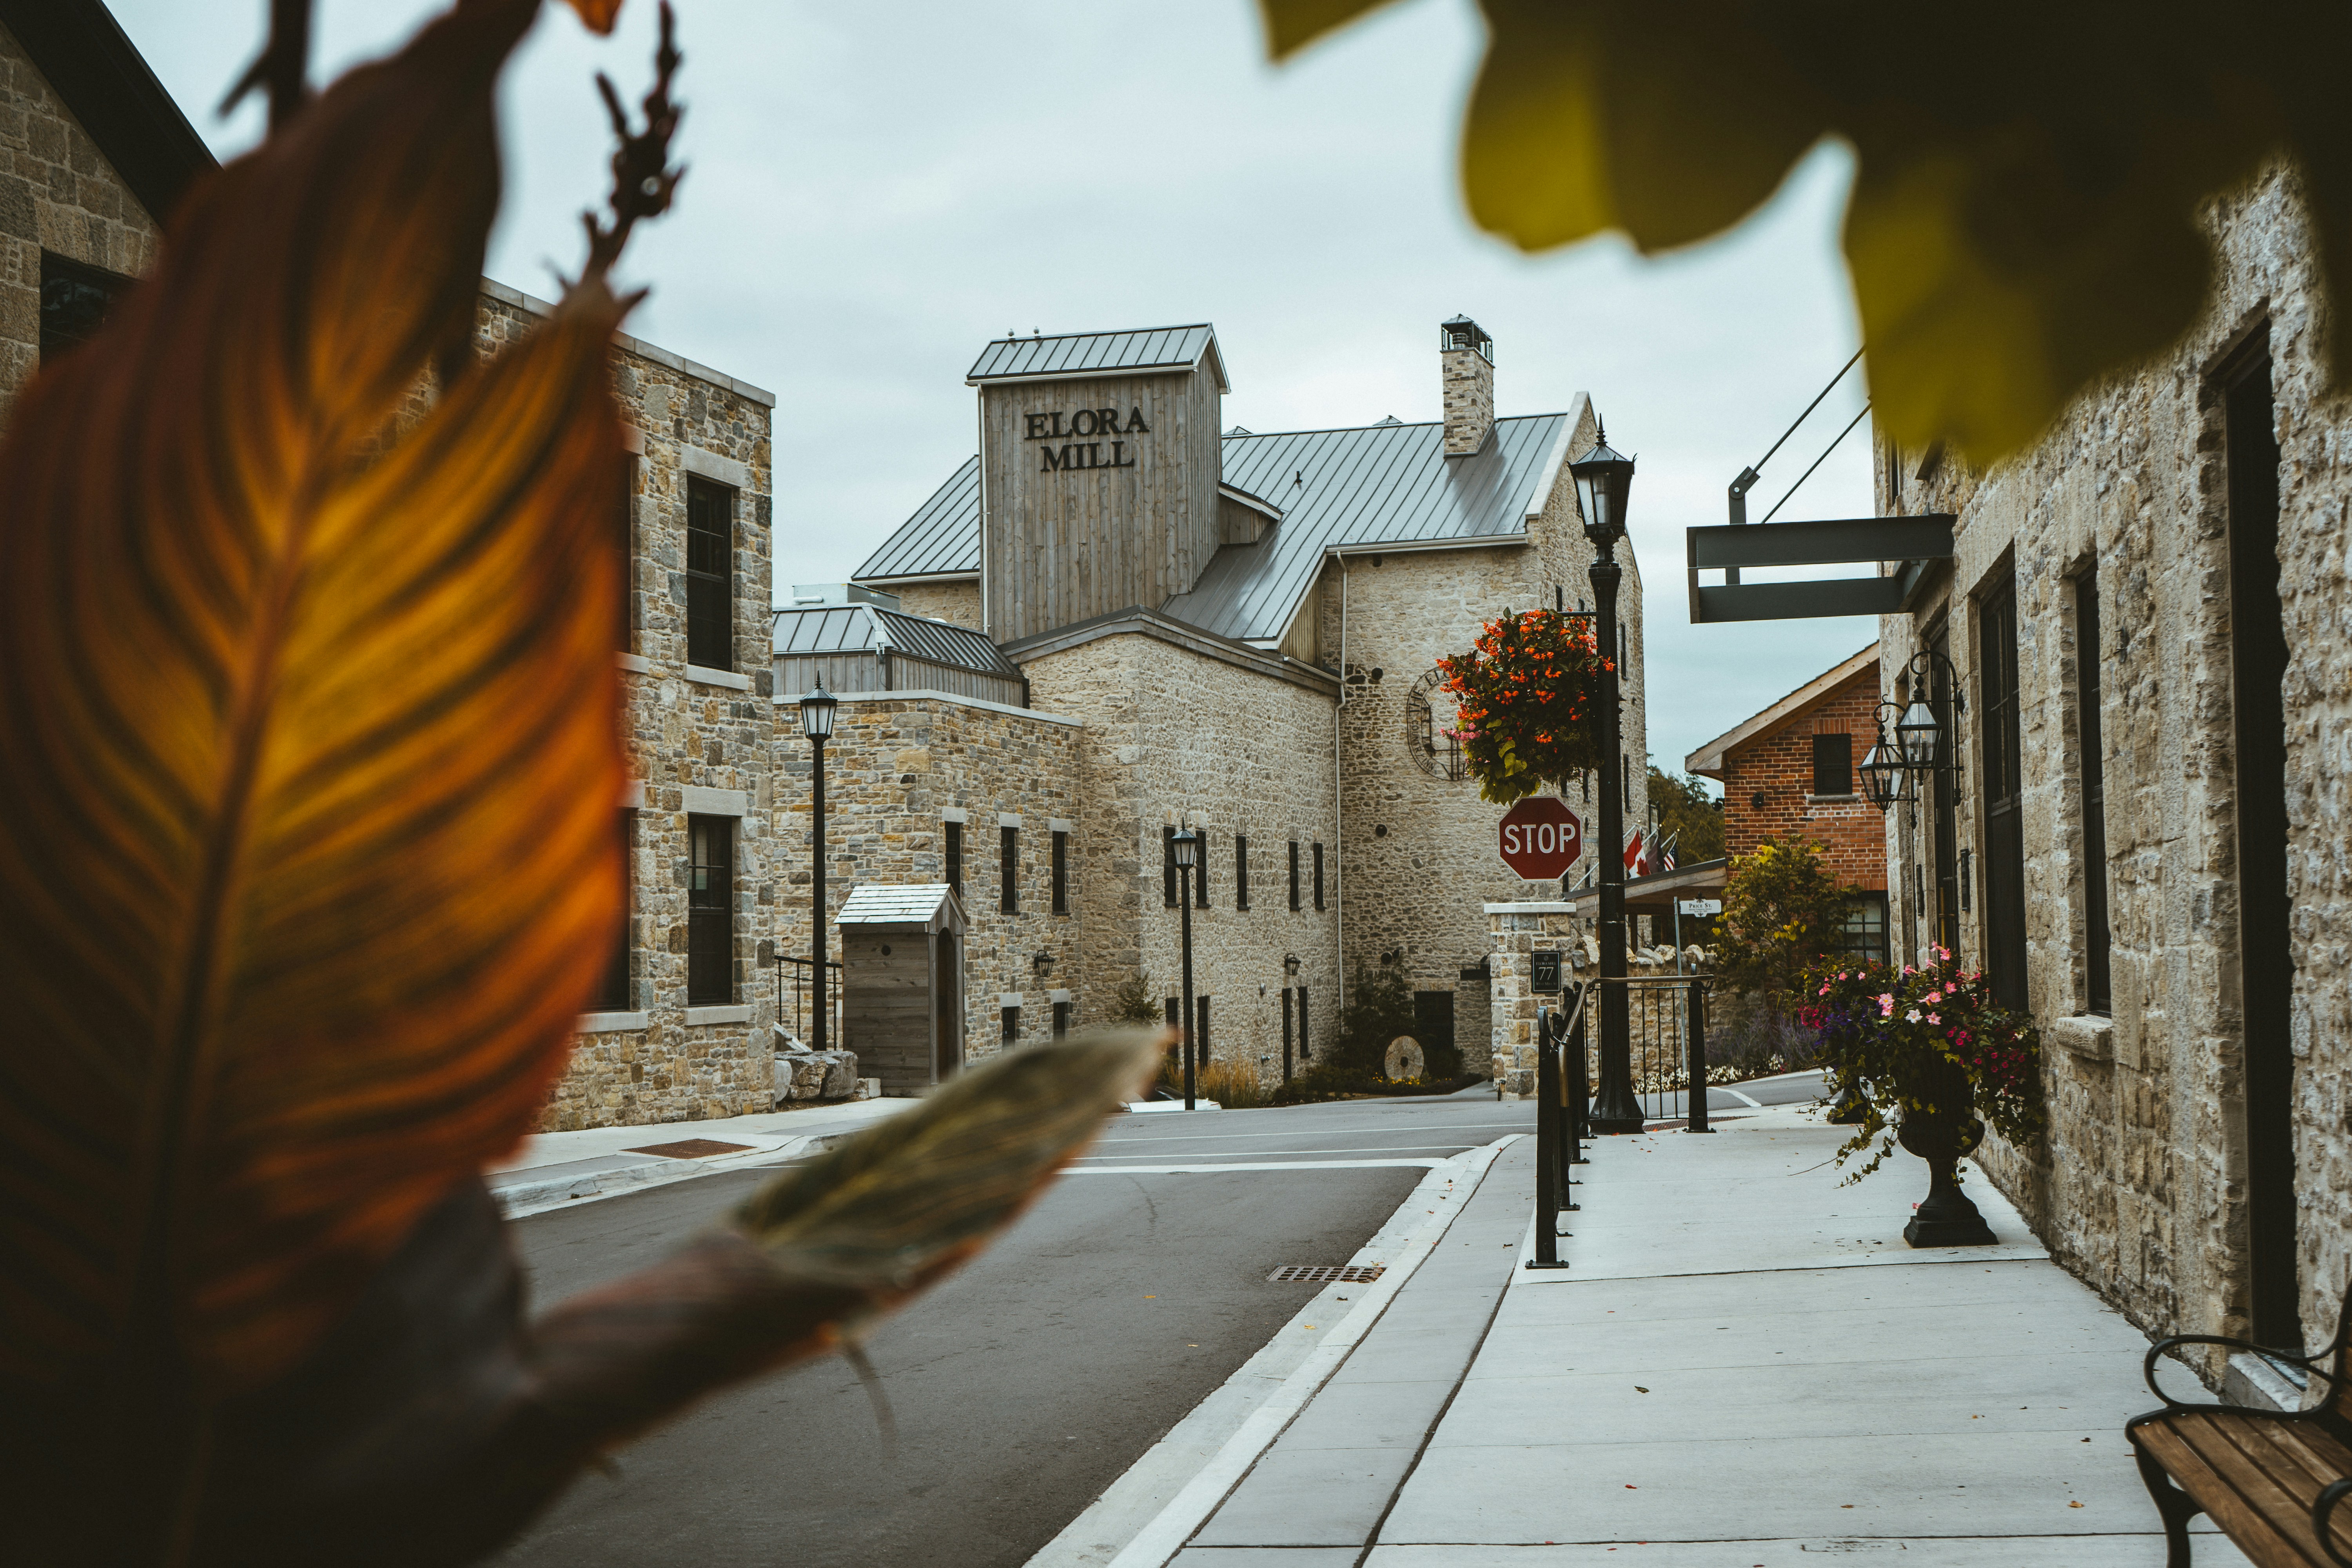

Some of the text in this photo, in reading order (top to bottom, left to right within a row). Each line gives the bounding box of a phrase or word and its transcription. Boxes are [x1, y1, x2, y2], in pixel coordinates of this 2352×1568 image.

[1024, 407, 1150, 440] ELORA
[1040, 441, 1134, 472] MILL
[1408, 686, 1427, 717] THE
[1411, 720, 1434, 771] COUNTRY INN
[1504, 823, 1576, 854] STOP
[1539, 967, 1554, 980] 77
